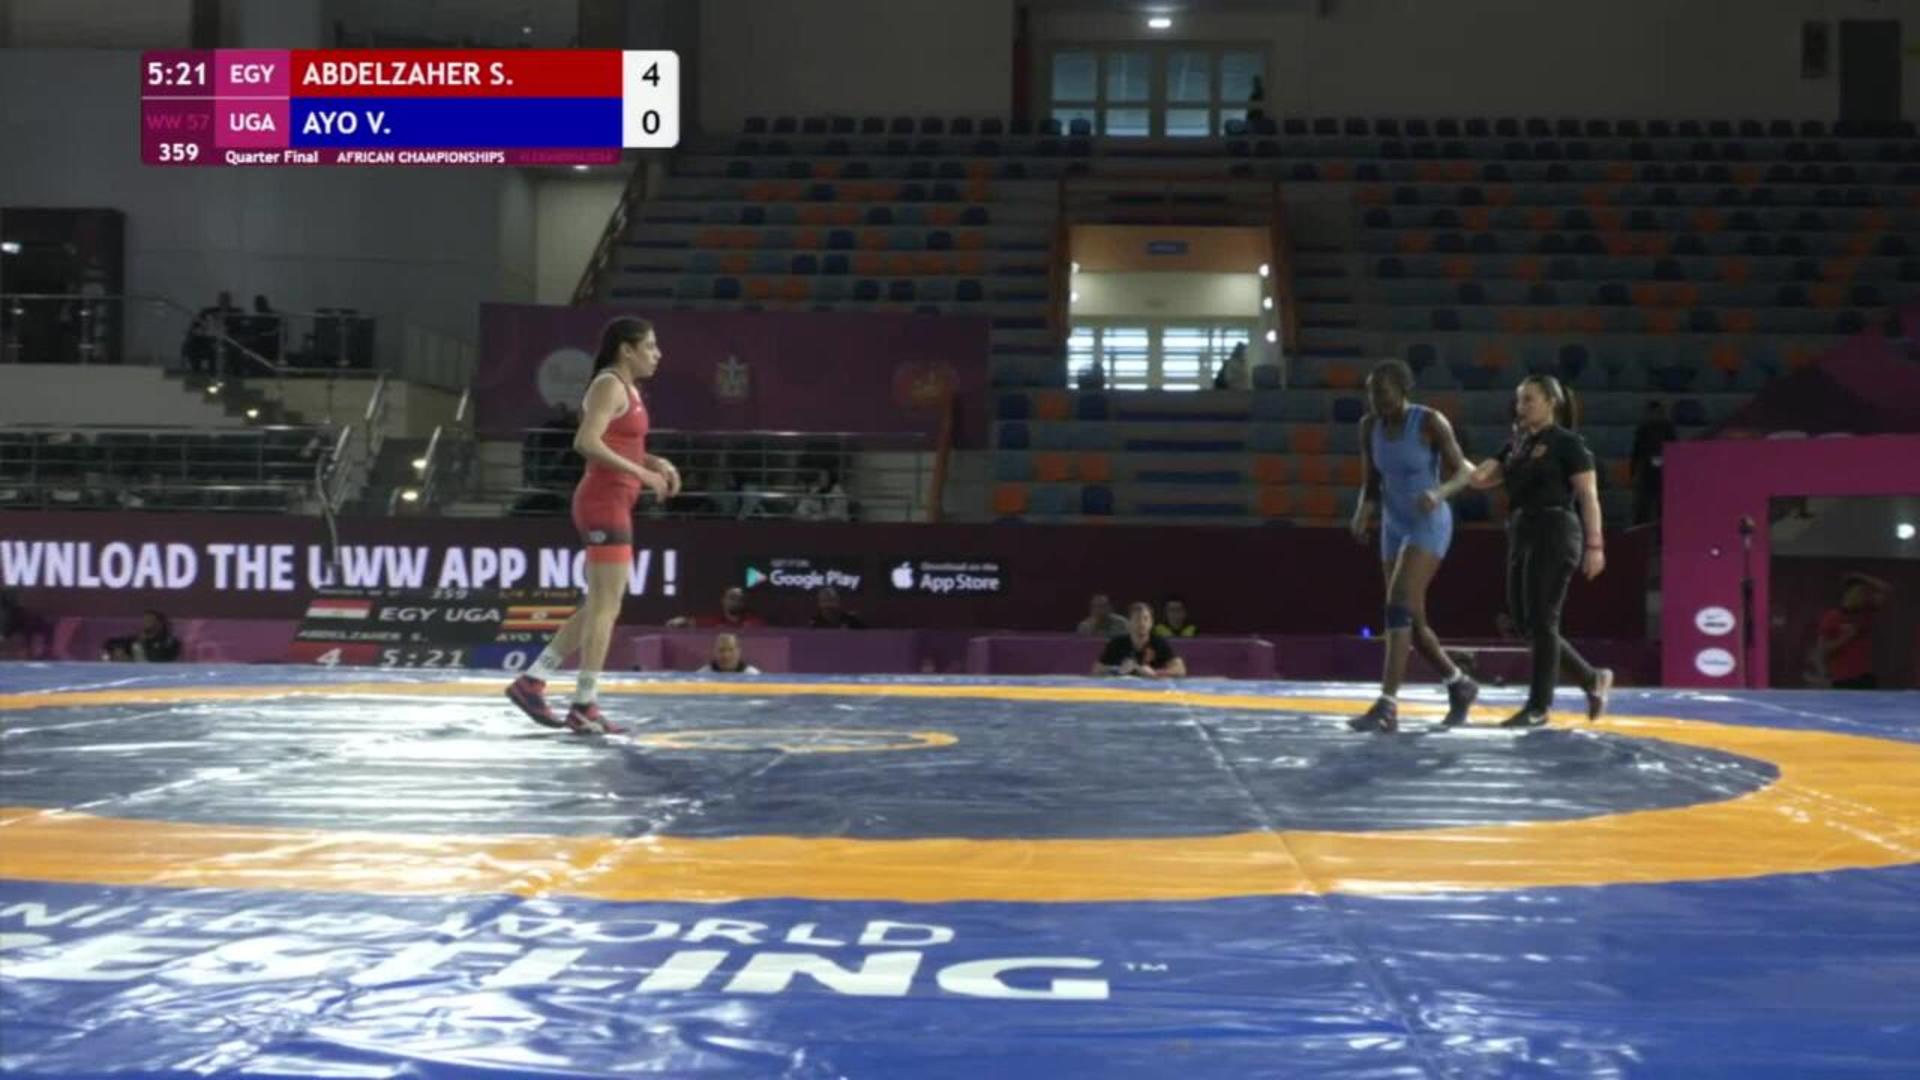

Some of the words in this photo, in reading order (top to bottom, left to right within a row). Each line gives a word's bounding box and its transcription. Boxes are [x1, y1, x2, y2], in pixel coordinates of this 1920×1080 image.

[0, 540, 197, 589] WNLOAD
[207, 544, 294, 590] THE
[308, 546, 429, 590] UWW
[438, 547, 527, 590] APP
[539, 549, 652, 596] NW
[664, 550, 677, 595] !
[769, 569, 824, 591] Google
[826, 569, 861, 591] Play
[920, 574, 955, 593] App
[956, 574, 1000, 591] Store
[380, 607, 437, 622] EGY
[445, 608, 500, 622] UGA
[317, 649, 341, 668] 4
[382, 649, 464, 668] 5:21
